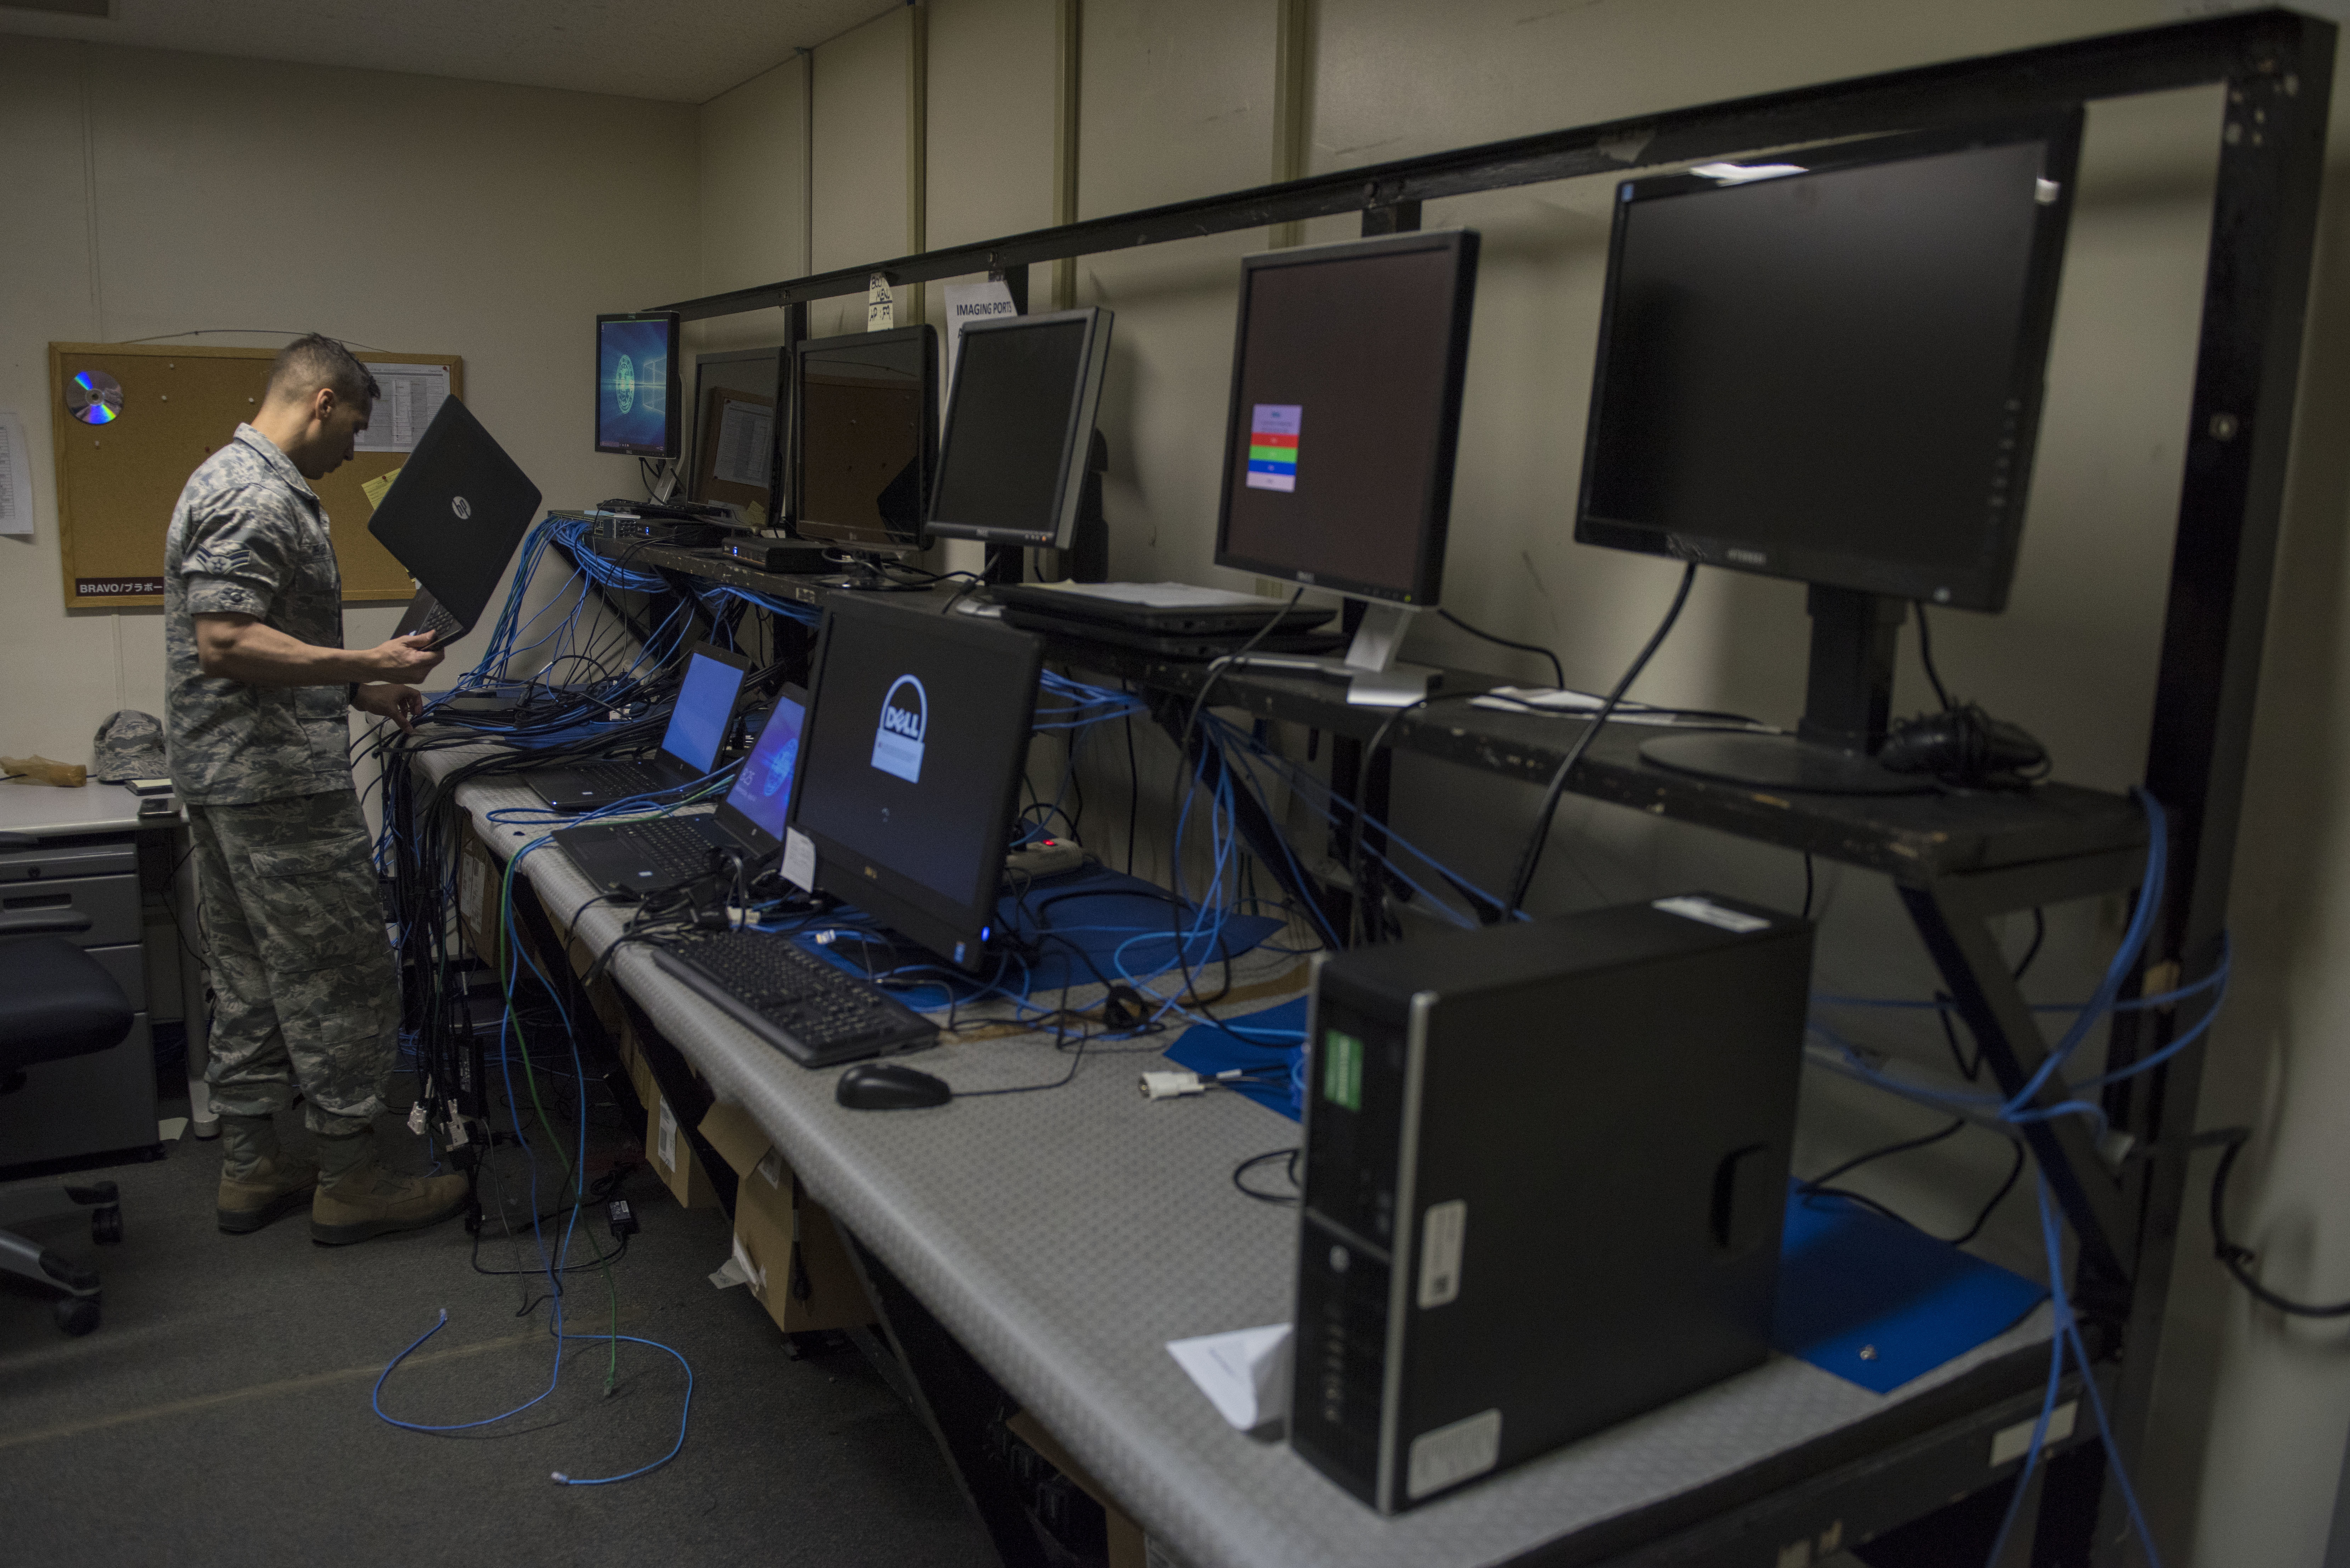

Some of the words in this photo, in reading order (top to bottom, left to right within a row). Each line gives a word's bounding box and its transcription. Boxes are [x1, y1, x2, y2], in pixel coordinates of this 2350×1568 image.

[876, 288, 890, 301] MENU
[957, 303, 992, 315] IMAGING
[993, 301, 1011, 314] PORTS
[452, 497, 470, 519] hp
[885, 706, 920, 739] DELL
